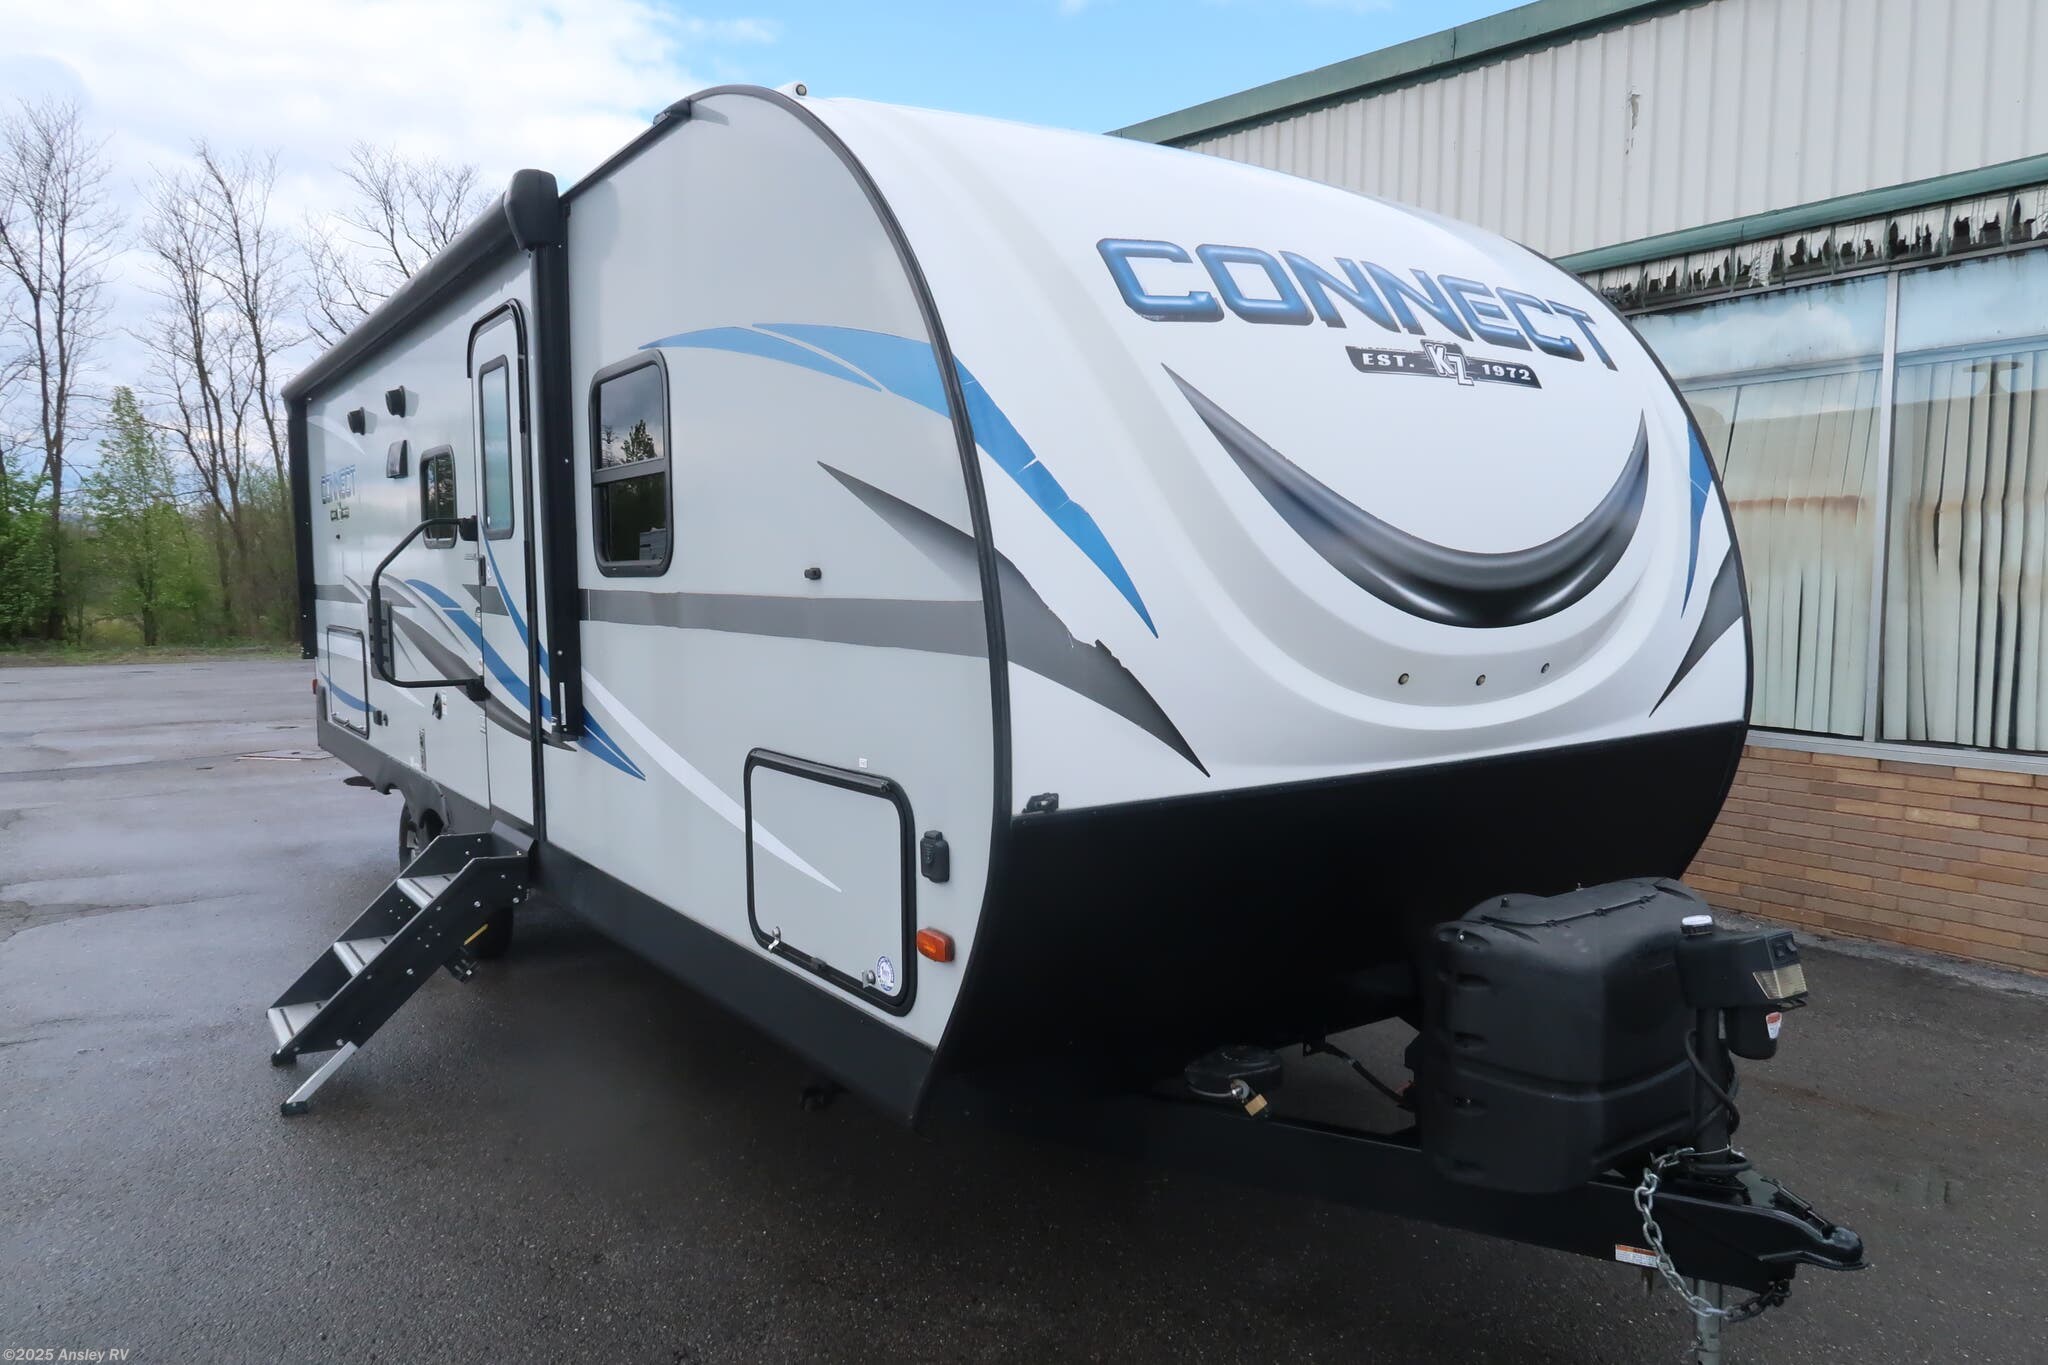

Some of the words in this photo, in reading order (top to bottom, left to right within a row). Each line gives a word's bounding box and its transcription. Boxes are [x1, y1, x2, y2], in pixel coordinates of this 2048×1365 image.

[1096, 238, 1617, 371] CONNECT
[1362, 353, 1415, 368] EST.
[1482, 364, 1532, 381] 1972
